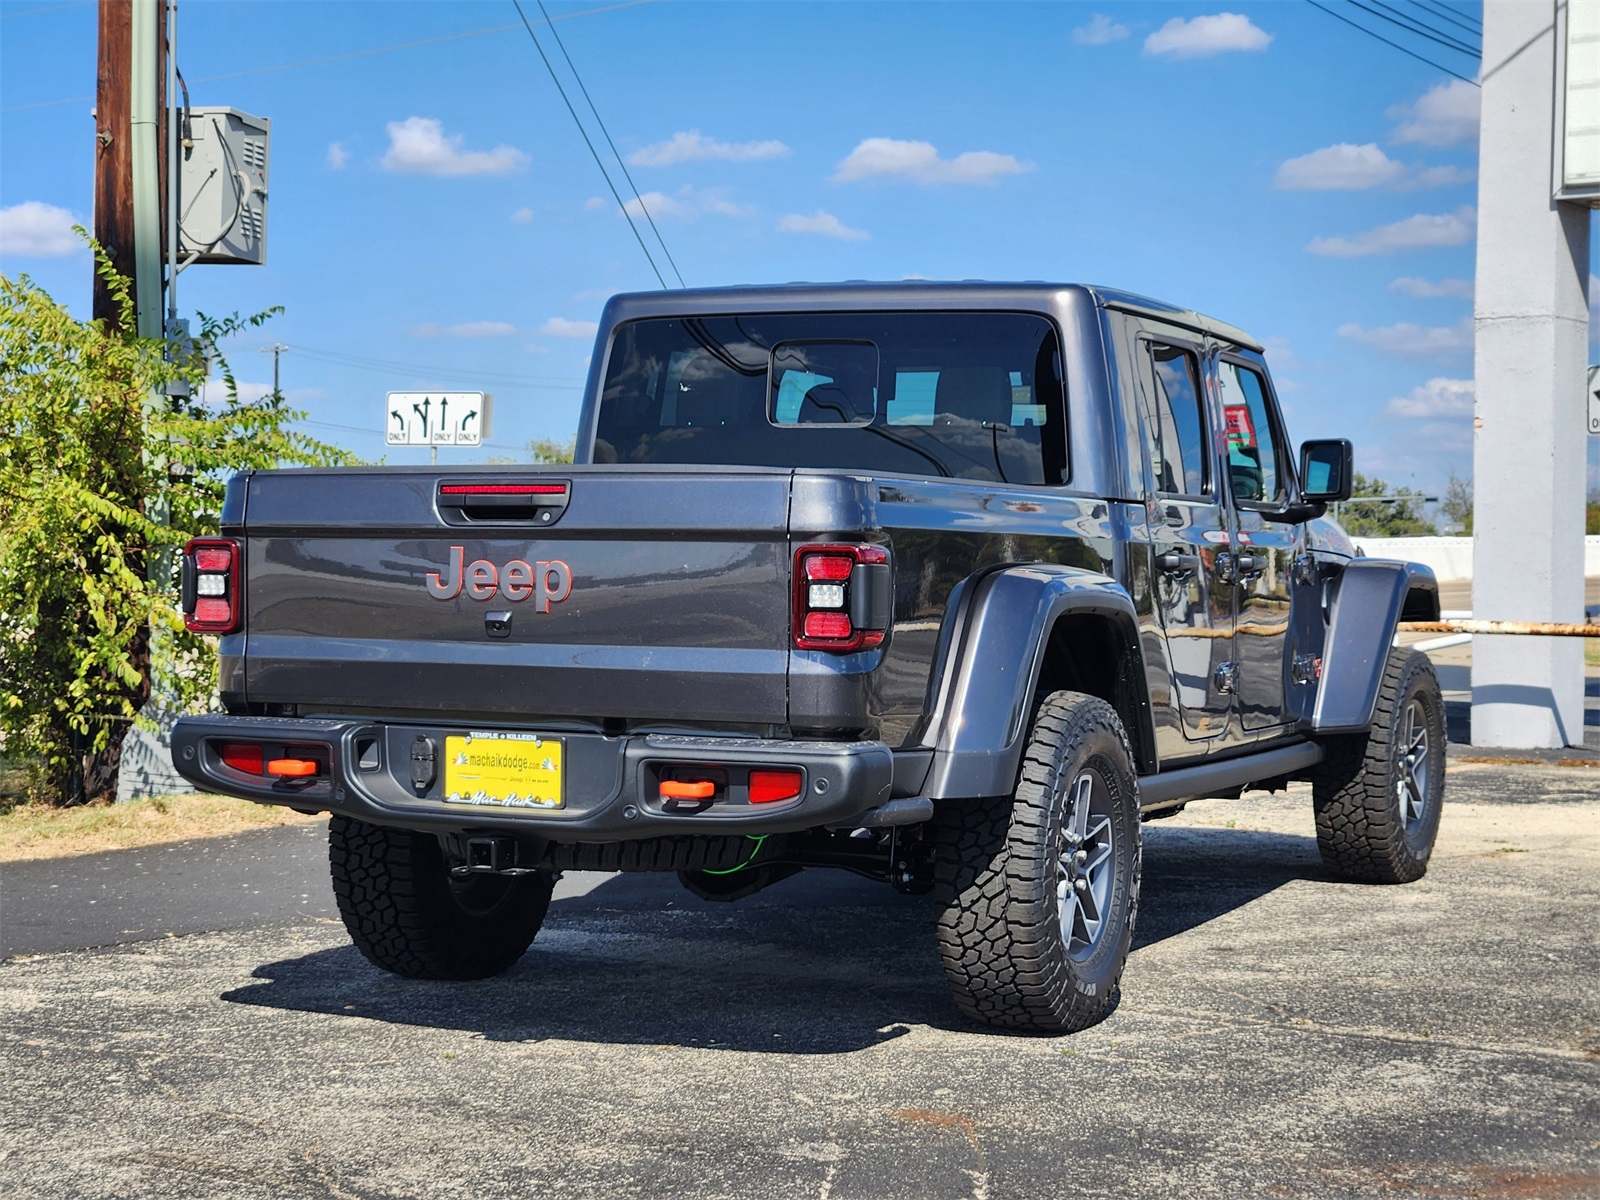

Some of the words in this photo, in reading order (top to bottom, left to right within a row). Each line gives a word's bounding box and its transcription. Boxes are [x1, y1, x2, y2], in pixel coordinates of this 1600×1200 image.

[388, 432, 406, 441] ONLY
[434, 432, 451, 441] ONLY
[458, 432, 478, 441] ONLY
[425, 545, 573, 614] Jeep
[469, 731, 499, 739] TEMPLE
[506, 733, 537, 741] KILLEEN
[469, 753, 541, 772] machaikdodge.com
[471, 789, 496, 805] Mac
[501, 792, 535, 807] Haik
